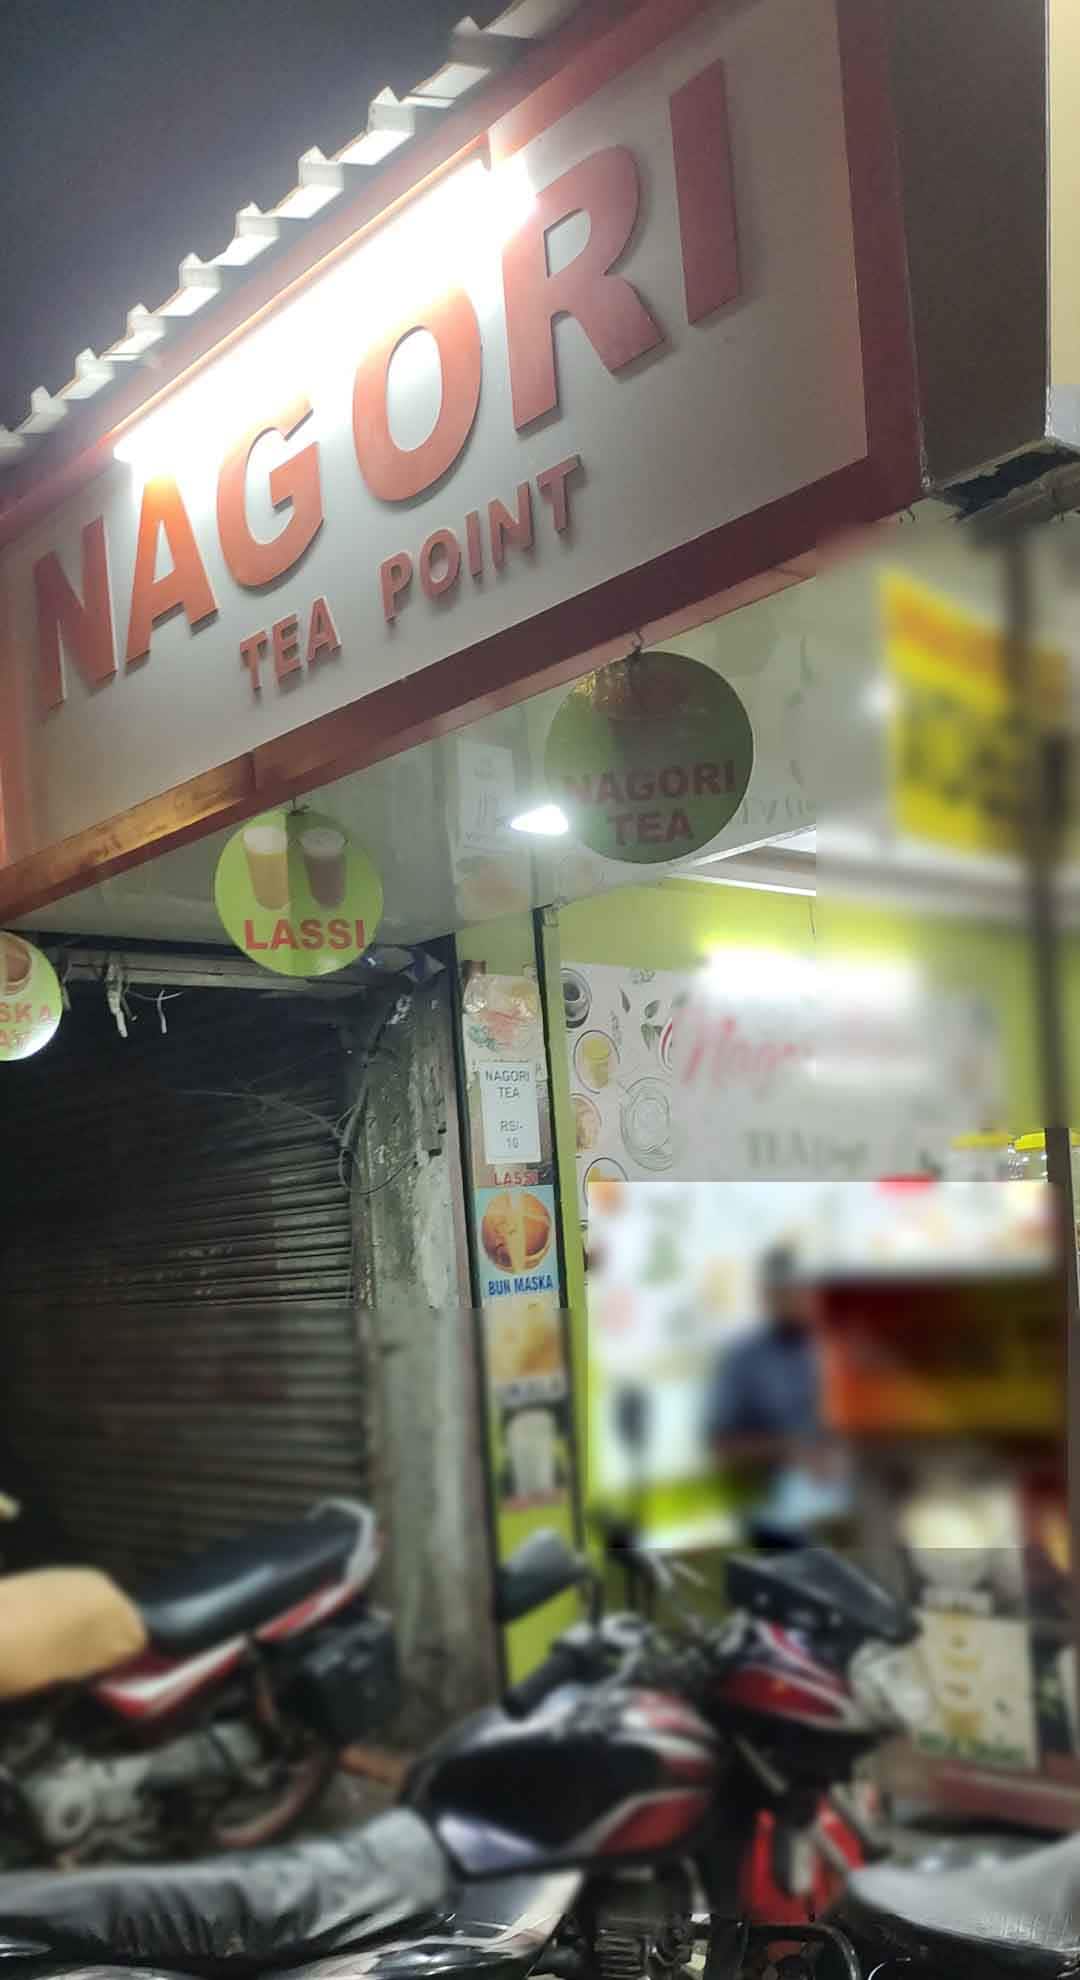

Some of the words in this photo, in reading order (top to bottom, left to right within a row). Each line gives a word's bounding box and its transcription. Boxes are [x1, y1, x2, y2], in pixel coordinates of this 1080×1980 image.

[30, 58, 738, 710] NAGORI
[239, 596, 342, 690] TEA
[379, 453, 582, 623] POINT
[565, 760, 736, 804] NAGORI
[608, 808, 694, 845] TEA
[244, 919, 365, 949] LASSI
[485, 1069, 530, 1082] NAGORI
[498, 1086, 520, 1098] TEA
[488, 1279, 512, 1296] BUN
[514, 1274, 554, 1293] MASKA
